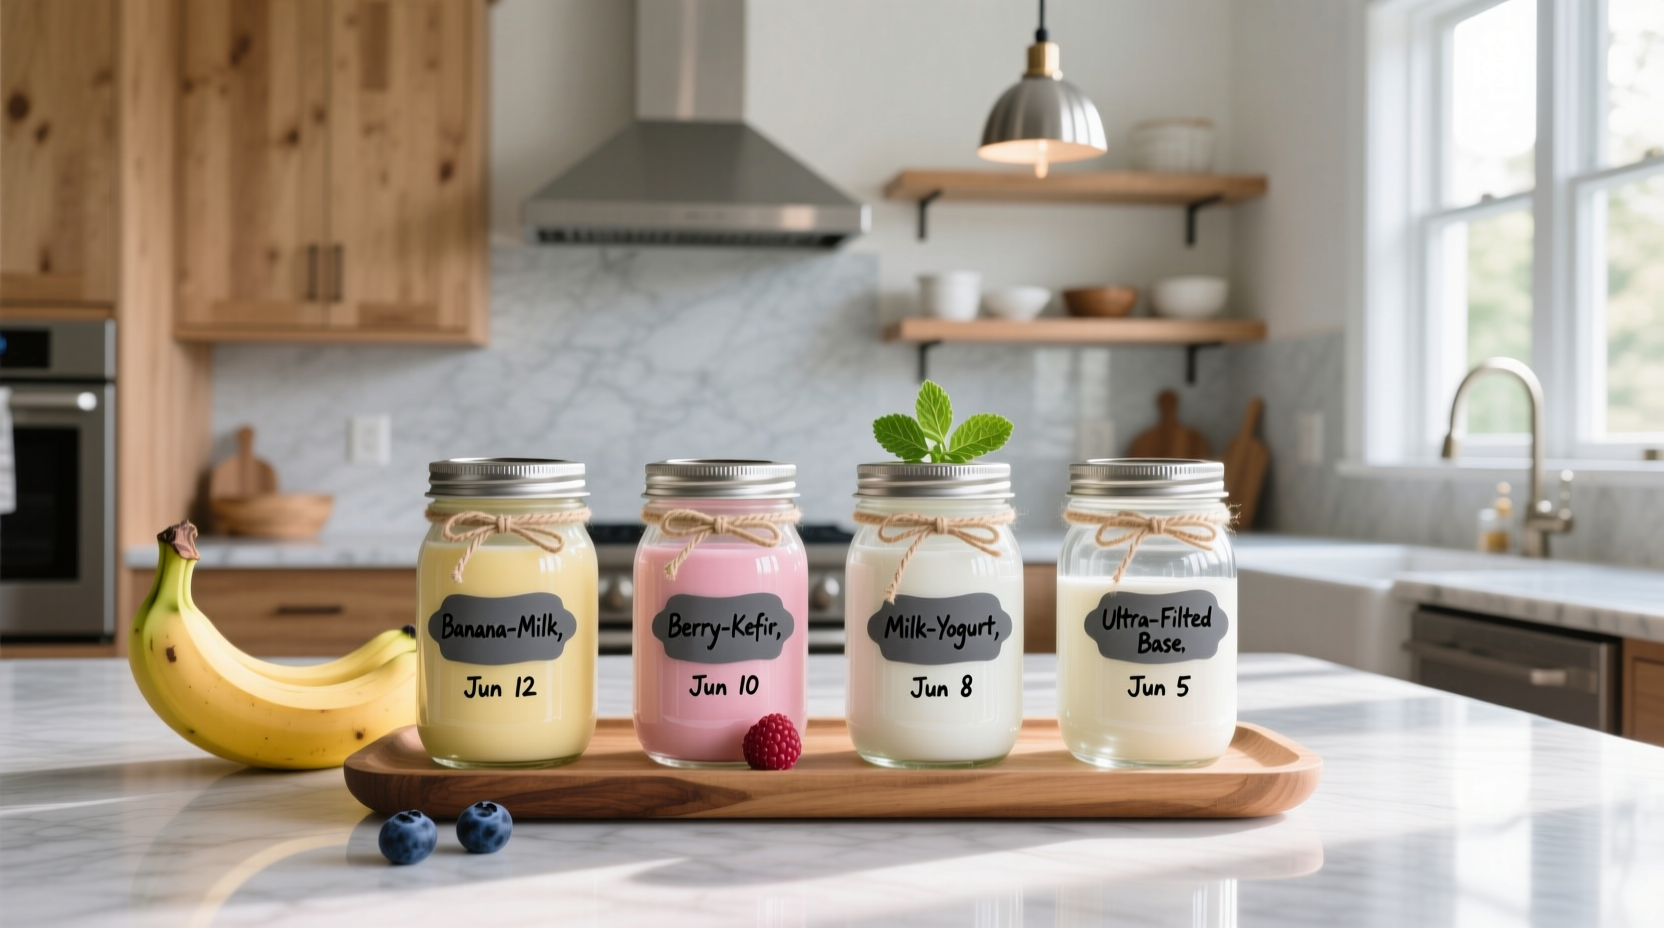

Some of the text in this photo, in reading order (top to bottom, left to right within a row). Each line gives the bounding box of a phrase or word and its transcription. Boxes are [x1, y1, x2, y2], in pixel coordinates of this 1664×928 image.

[441, 612, 563, 643] Banana-Milk,
[1101, 605, 1212, 631] Ultra-Filted
[667, 612, 782, 651] Berry-Kefir,
[883, 613, 1001, 650] Milk-Yogurt,
[463, 676, 537, 699] Jun 12
[689, 674, 759, 697] Jun 10
[910, 674, 973, 699] Jun 8
[1127, 675, 1192, 698] Jun 5
